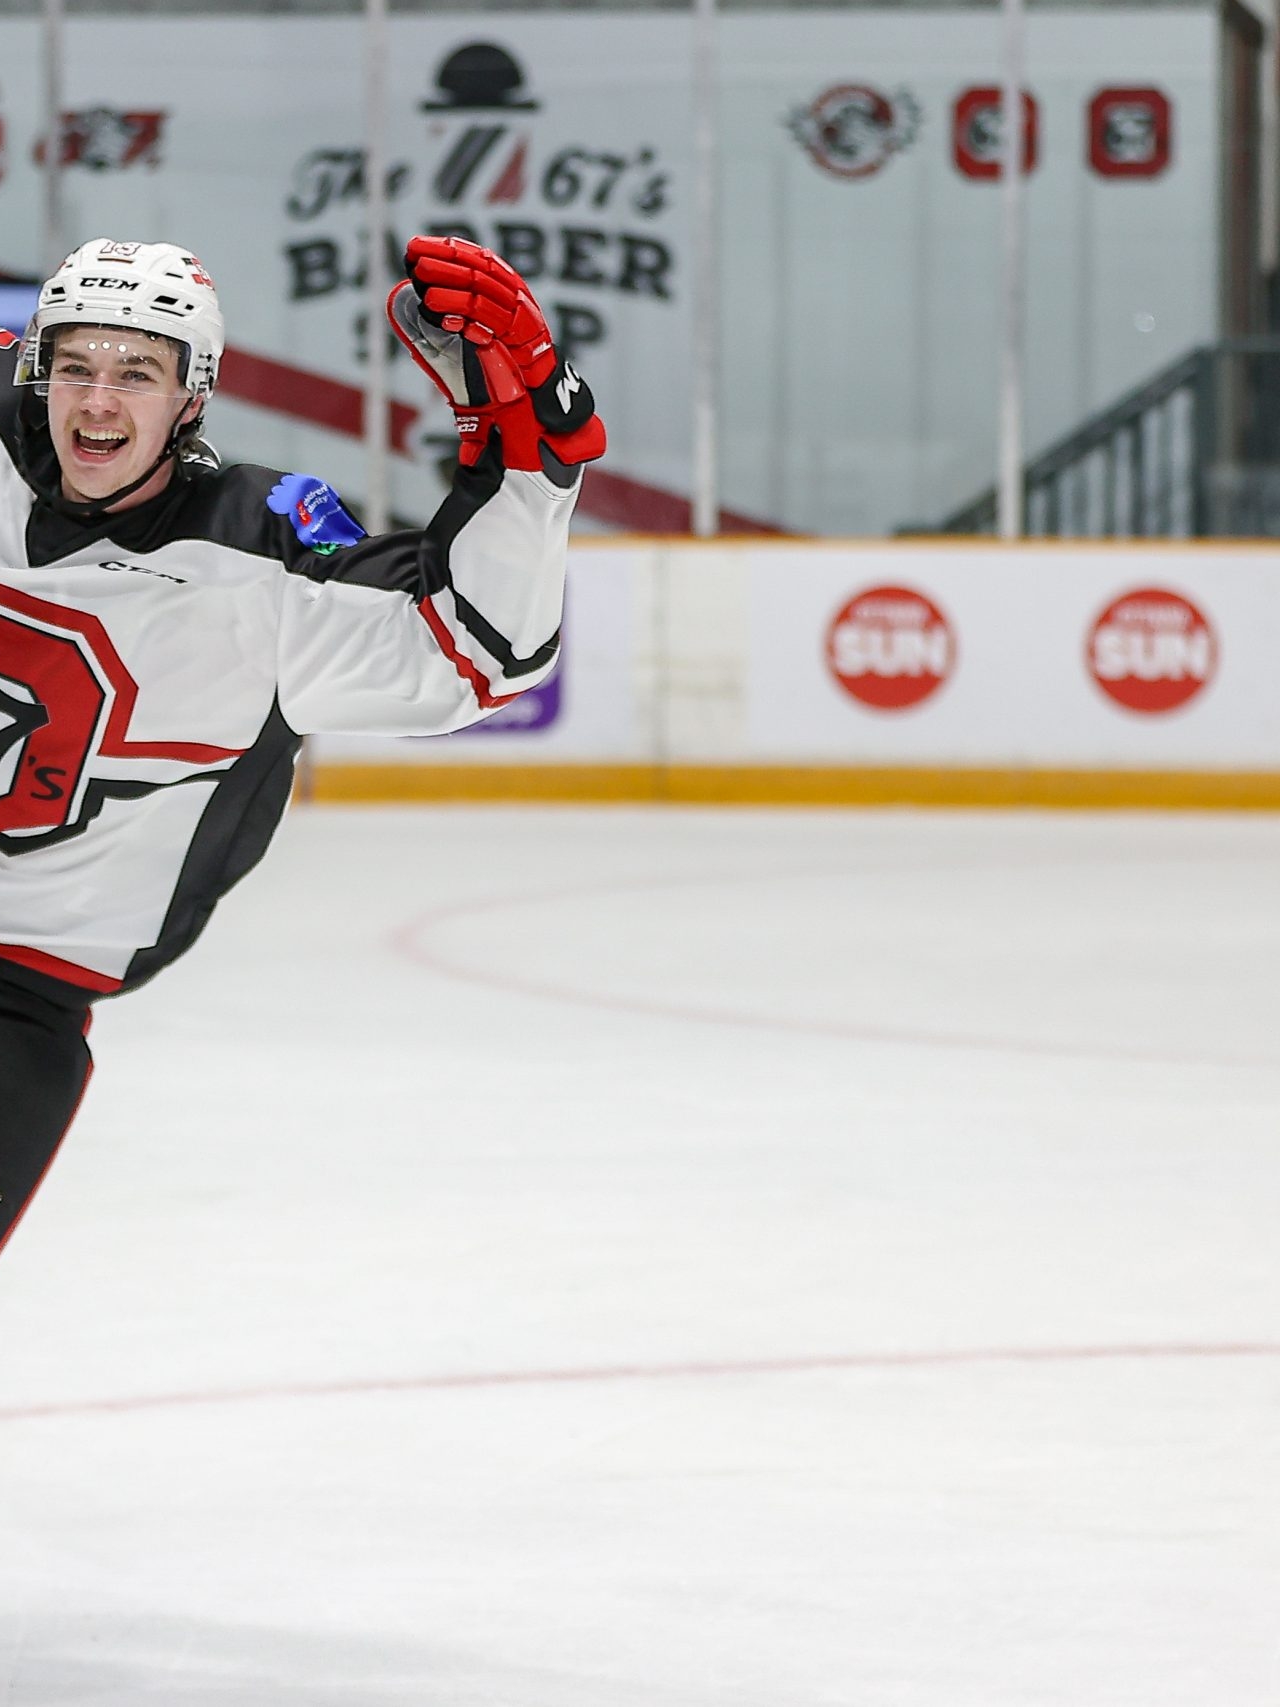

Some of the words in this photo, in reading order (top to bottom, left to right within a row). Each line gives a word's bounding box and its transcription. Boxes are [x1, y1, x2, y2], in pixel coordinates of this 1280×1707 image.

[540, 145, 669, 218] 67's
[79, 277, 142, 292] CCM
[98, 560, 188, 585] CCM
[834, 626, 947, 678] SUN
[1094, 629, 1208, 682] SUN
